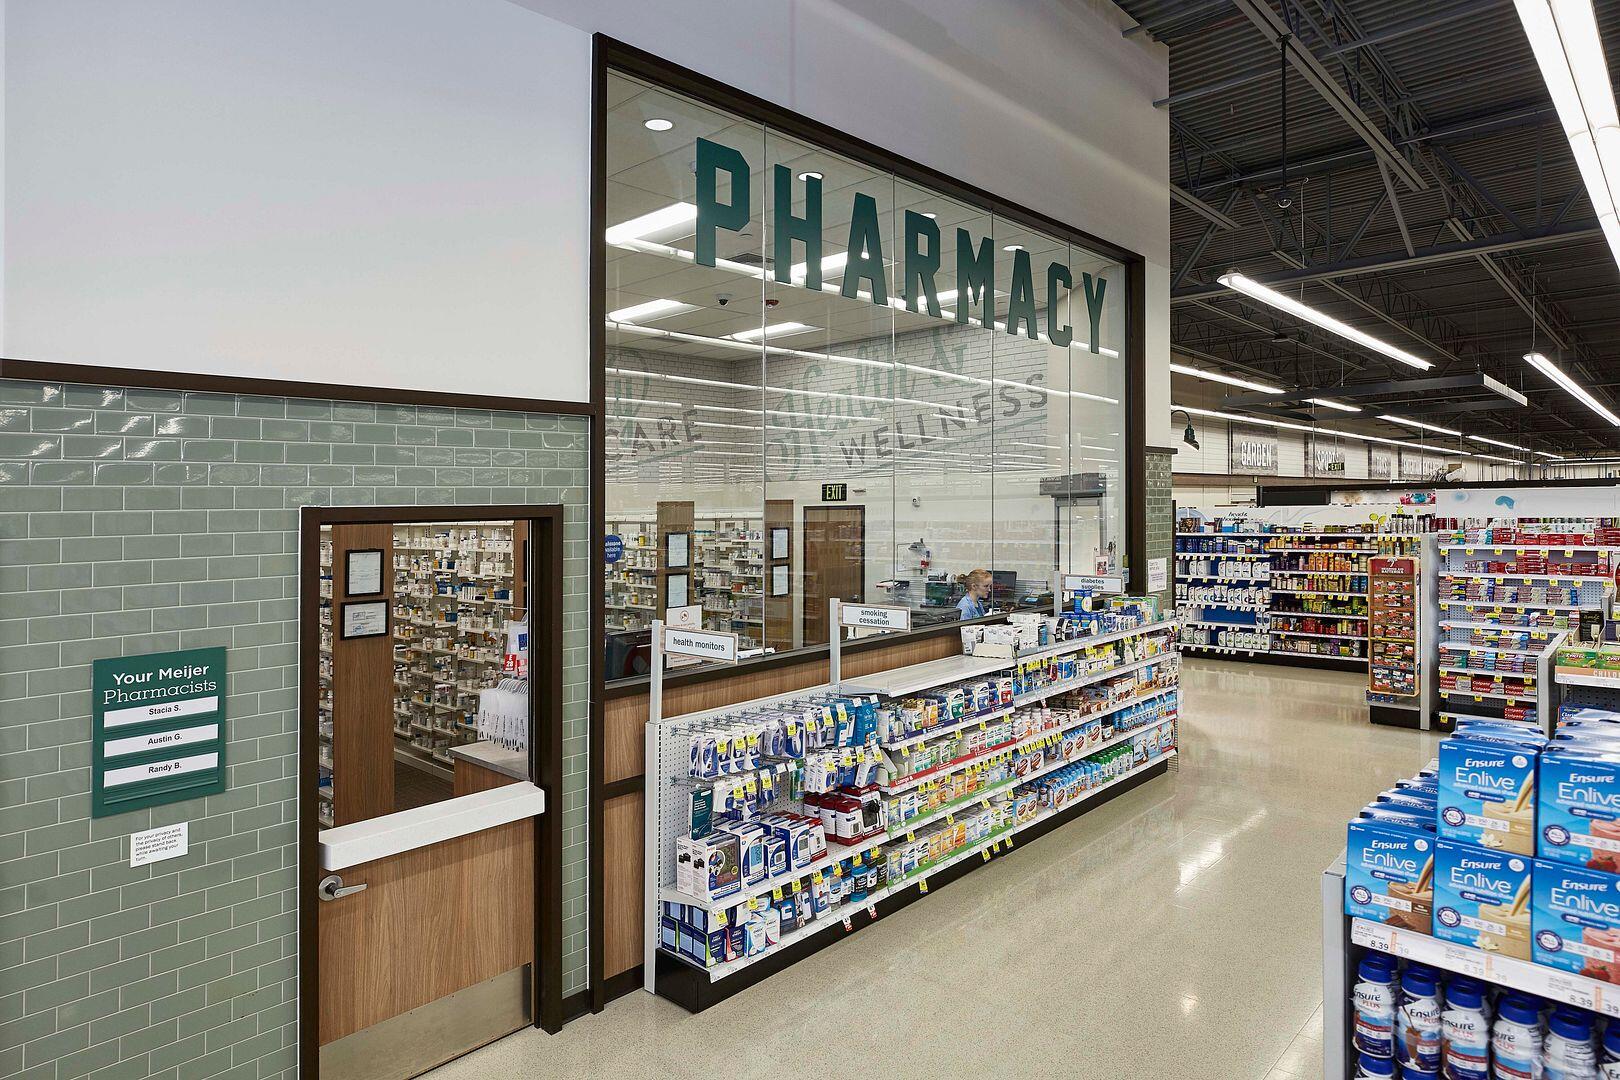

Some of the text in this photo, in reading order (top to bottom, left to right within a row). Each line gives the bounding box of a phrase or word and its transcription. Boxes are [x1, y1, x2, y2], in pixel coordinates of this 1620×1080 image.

[695, 137, 1107, 354] PHARMACY
[838, 373, 1048, 470] WELLNESS
[1240, 441, 1272, 467] GARDEN
[826, 485, 843, 500] EXIT
[860, 609, 888, 619] smoking
[858, 617, 890, 626] cessation
[673, 637, 725, 652] health monitors
[113, 665, 210, 686] Your Meijer
[1593, 669, 1620, 679] CHILD
[103, 680, 217, 705] Pharmacists
[149, 704, 182, 716] Stacia S.
[148, 733, 183, 745] Austin G.
[148, 764, 173, 774] Randy
[1465, 758, 1505, 768] Ensure
[1455, 766, 1515, 790] Enlive
[1569, 773, 1615, 783] Ensure
[1371, 840, 1408, 850] Ensure
[1363, 847, 1417, 872] Enlive
[1461, 858, 1502, 870] Ensure
[1451, 867, 1512, 894] Enlive
[1561, 879, 1608, 892] Ensure
[1551, 887, 1620, 917] Enlive
[1370, 939, 1389, 951] 8.39
[1569, 994, 1593, 1008] 8.39
